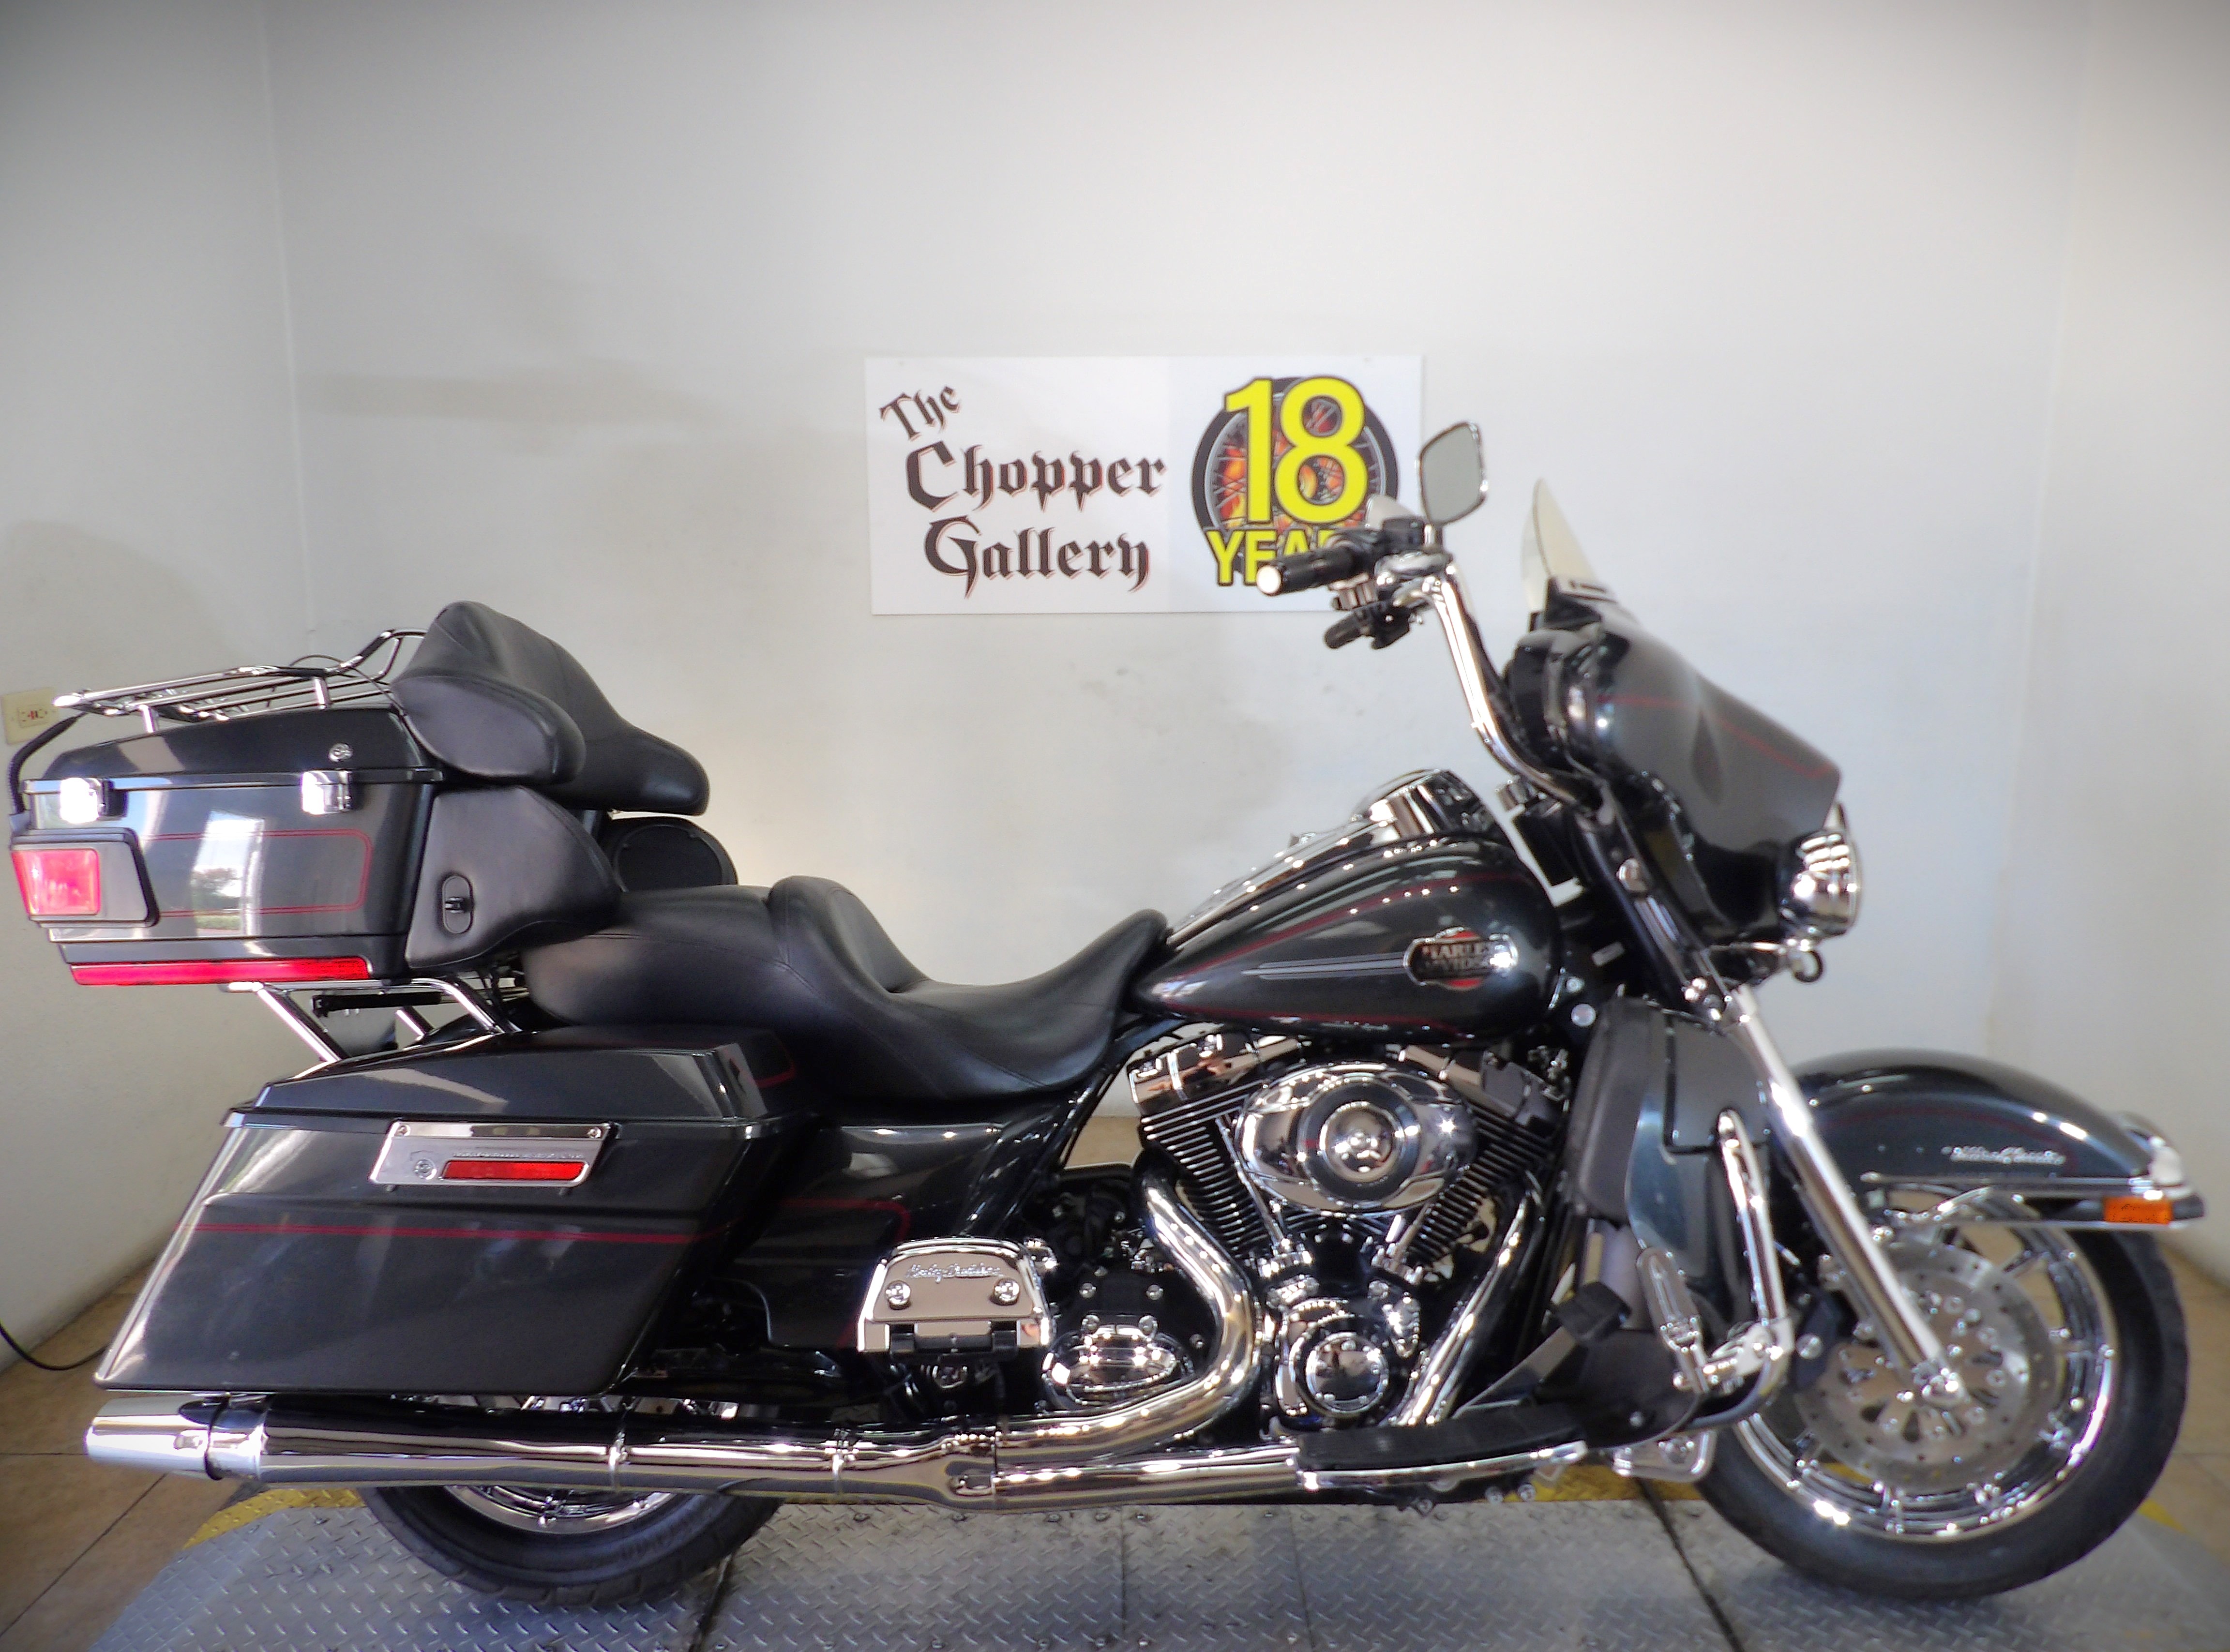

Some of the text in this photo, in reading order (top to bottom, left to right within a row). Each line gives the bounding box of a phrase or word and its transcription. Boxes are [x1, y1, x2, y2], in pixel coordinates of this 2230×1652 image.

[878, 385, 962, 441] The
[1223, 375, 1369, 525] 18
[905, 440, 1166, 513] Chopper
[923, 515, 1150, 599] Gallery
